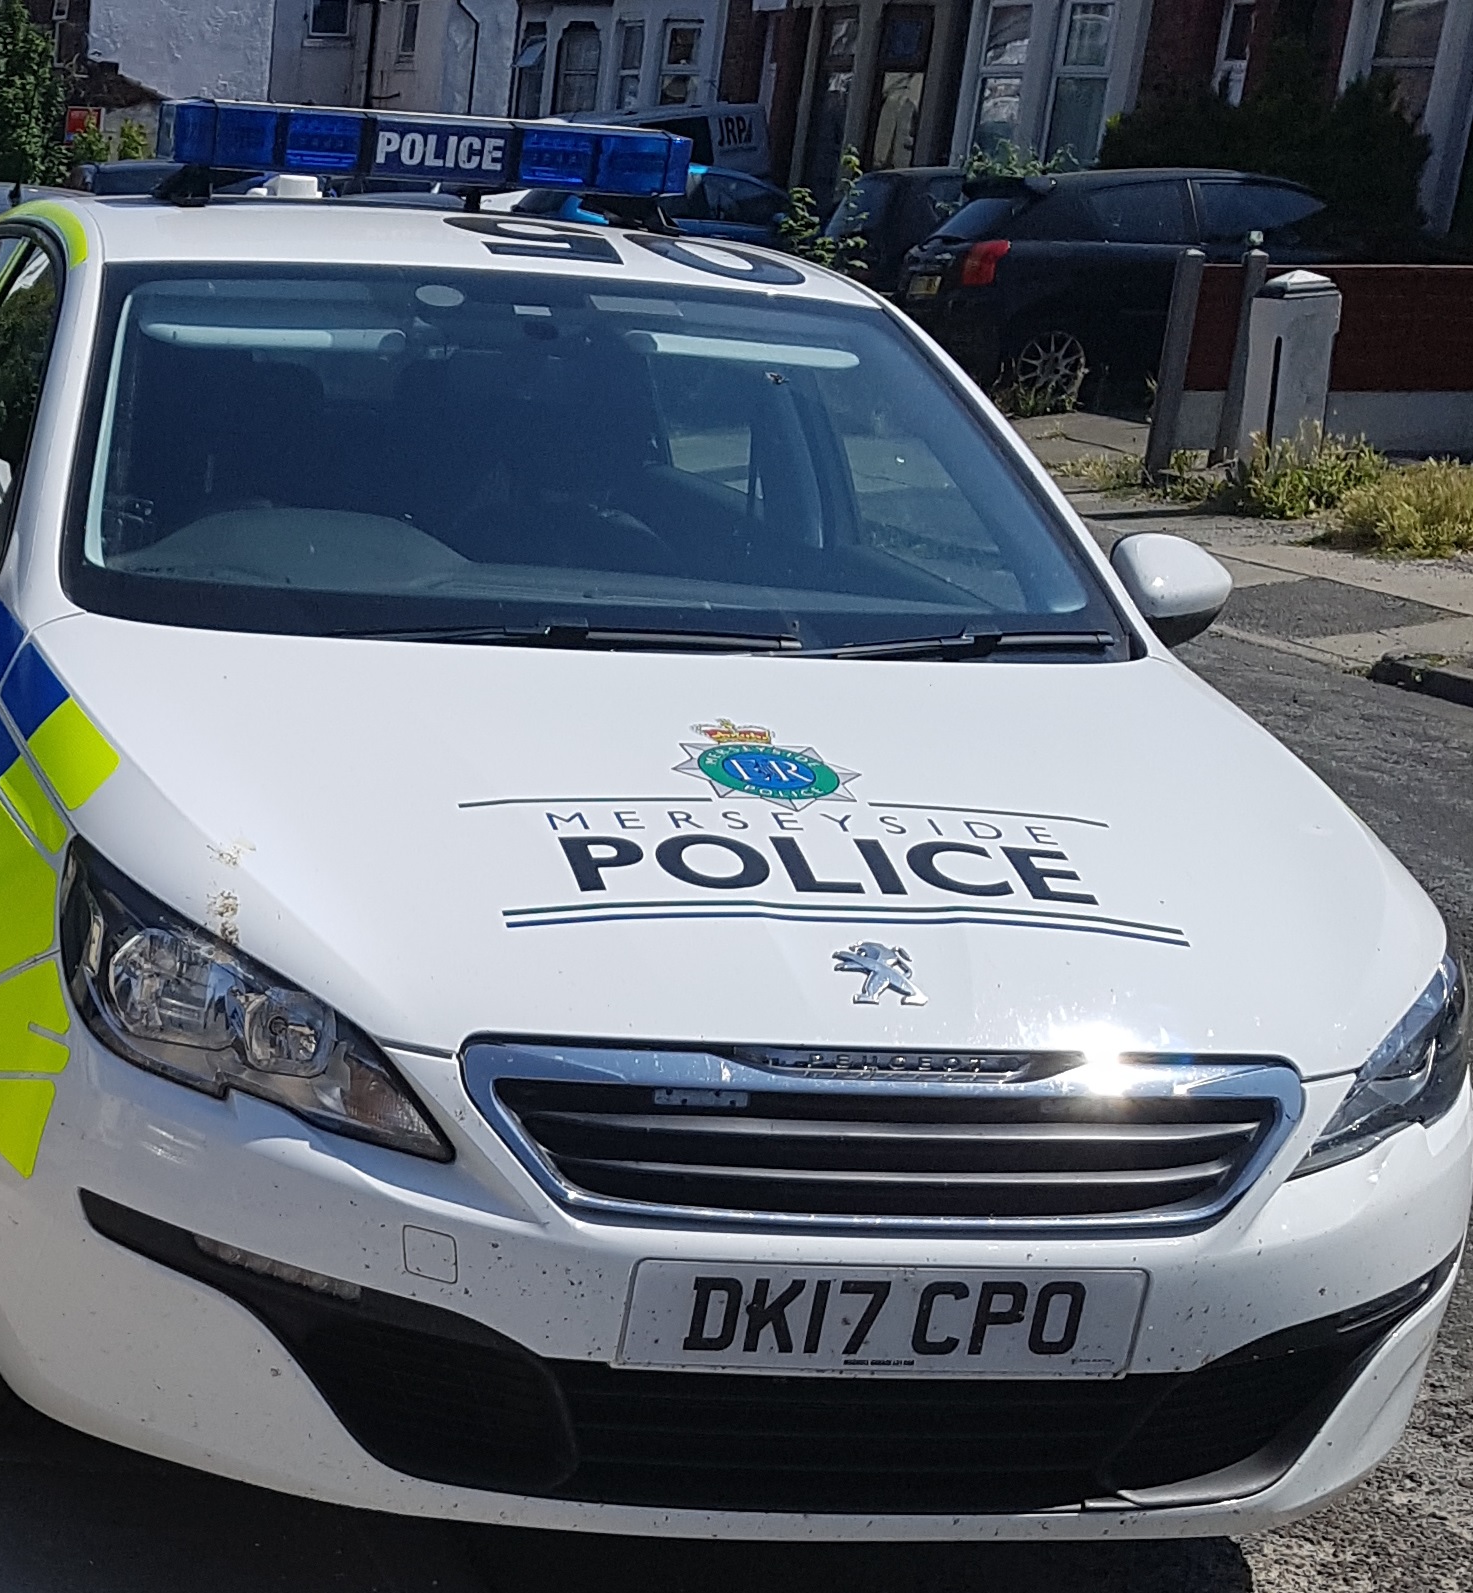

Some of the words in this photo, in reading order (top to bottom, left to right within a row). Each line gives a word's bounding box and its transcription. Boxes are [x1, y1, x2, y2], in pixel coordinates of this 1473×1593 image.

[375, 130, 505, 172] POLICE
[704, 745, 821, 769] MERSEYSIDE
[743, 783, 824, 799] POLICE
[545, 810, 1059, 847] MERSEYSIDE
[558, 833, 1100, 906] POLICE
[808, 1053, 987, 1072] PEUGEOT
[682, 1276, 892, 1356] DK17
[911, 1280, 1088, 1356] CPO
